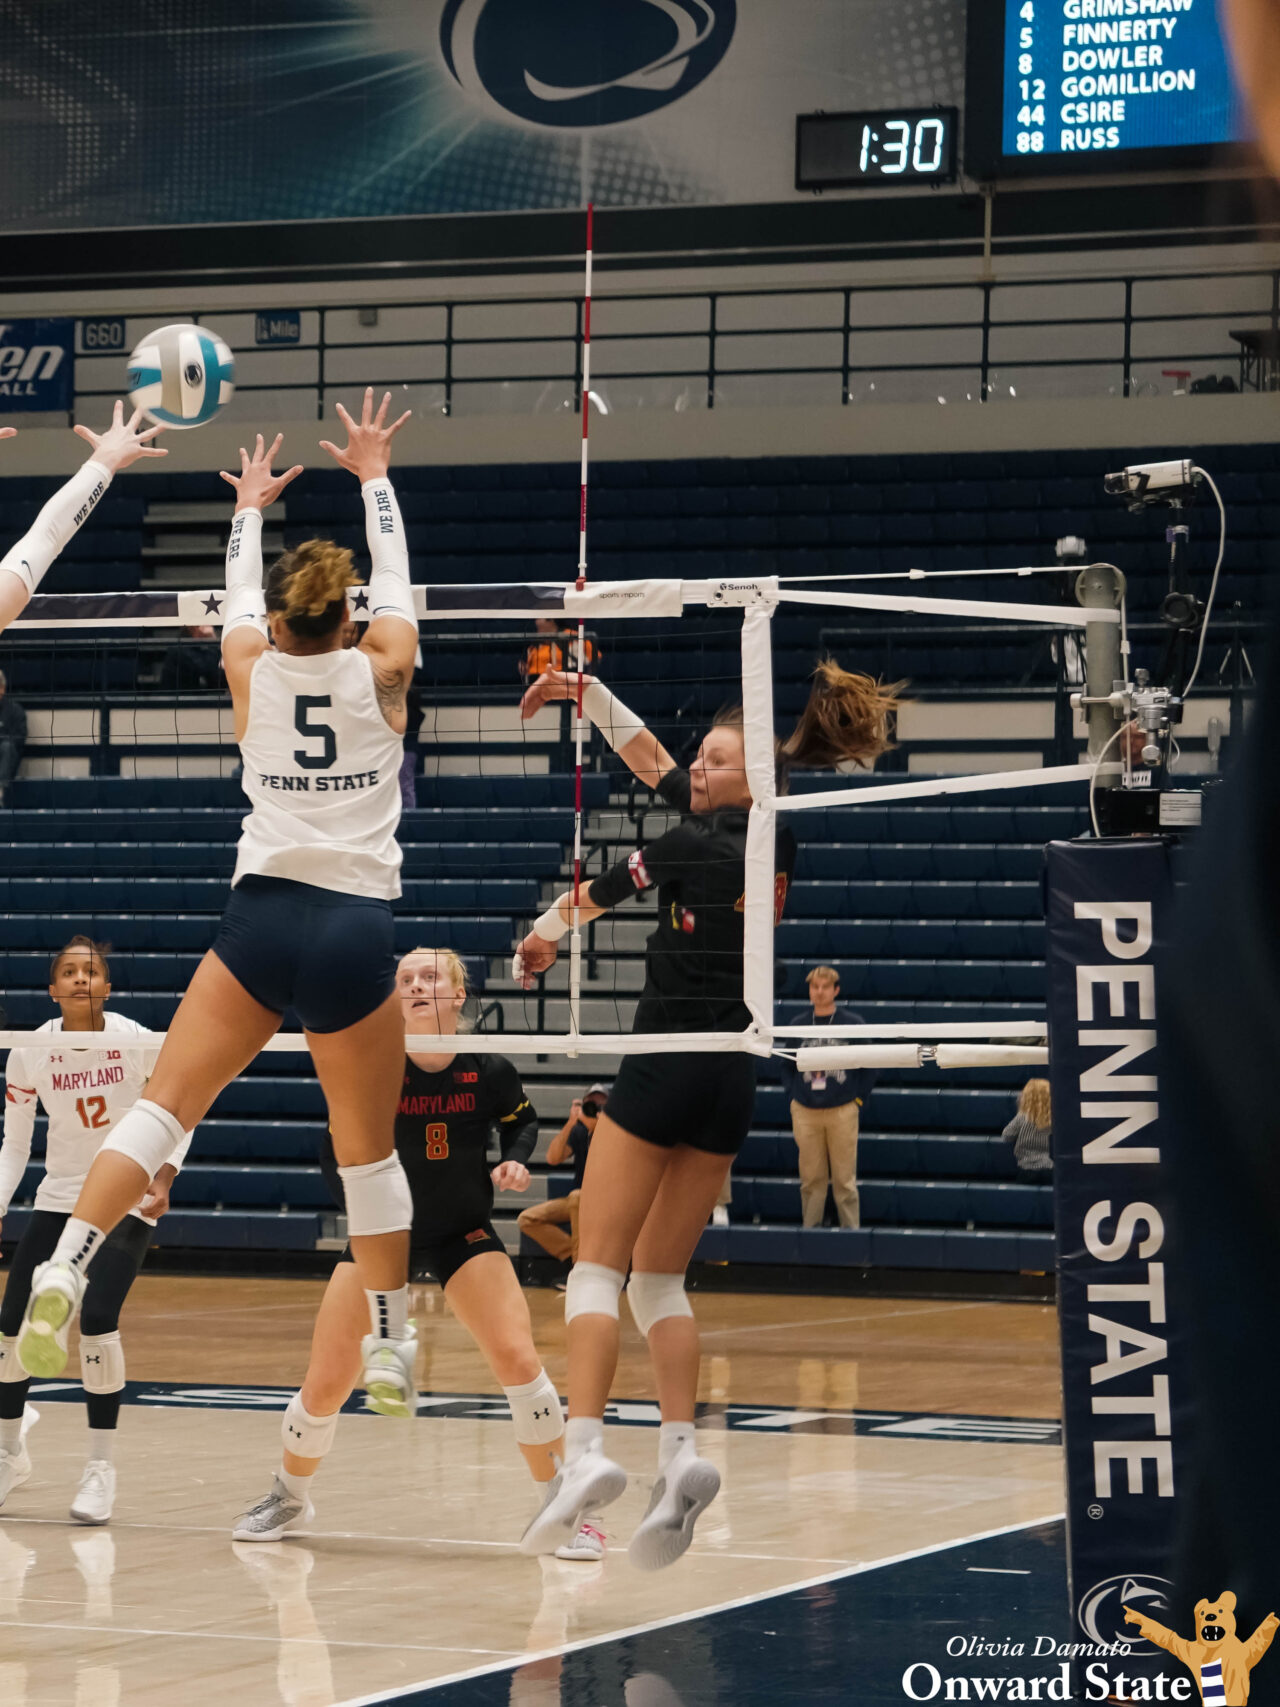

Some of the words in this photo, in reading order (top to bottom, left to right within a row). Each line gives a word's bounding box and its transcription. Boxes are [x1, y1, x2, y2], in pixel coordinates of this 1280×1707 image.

[1020, 1, 1034, 22] 4
[1063, 0, 1193, 19] GRIMSHAW
[1020, 27, 1033, 48] 5
[1063, 17, 1177, 46] FINNERTY
[1018, 53, 1033, 75] 8
[1062, 45, 1163, 72] DOWLER
[1019, 79, 1046, 101] 12
[1061, 69, 1195, 98] GOMILLION
[1017, 104, 1046, 127] 44
[1060, 100, 1125, 124] CSIRE
[859, 118, 946, 174] 1:30
[1016, 131, 1044, 153] 88
[1060, 127, 1120, 151] RUSS
[86, 323, 122, 346] 660
[270, 319, 299, 338] Mile
[73, 504, 88, 526] WE
[88, 480, 105, 509] ARE
[375, 489, 392, 512] ARE
[379, 515, 394, 533] WE
[727, 583, 758, 591] Senoh
[293, 694, 337, 769] 5
[258, 773, 309, 791] PENN
[315, 770, 379, 791] STATE
[1073, 901, 1161, 1164] PENN
[52, 1066, 124, 1091] MARYLAND
[75, 1095, 110, 1129] 12
[397, 1093, 475, 1115] MARYLAND
[426, 1122, 449, 1160] 8
[1082, 1201, 1175, 1498] STATE
